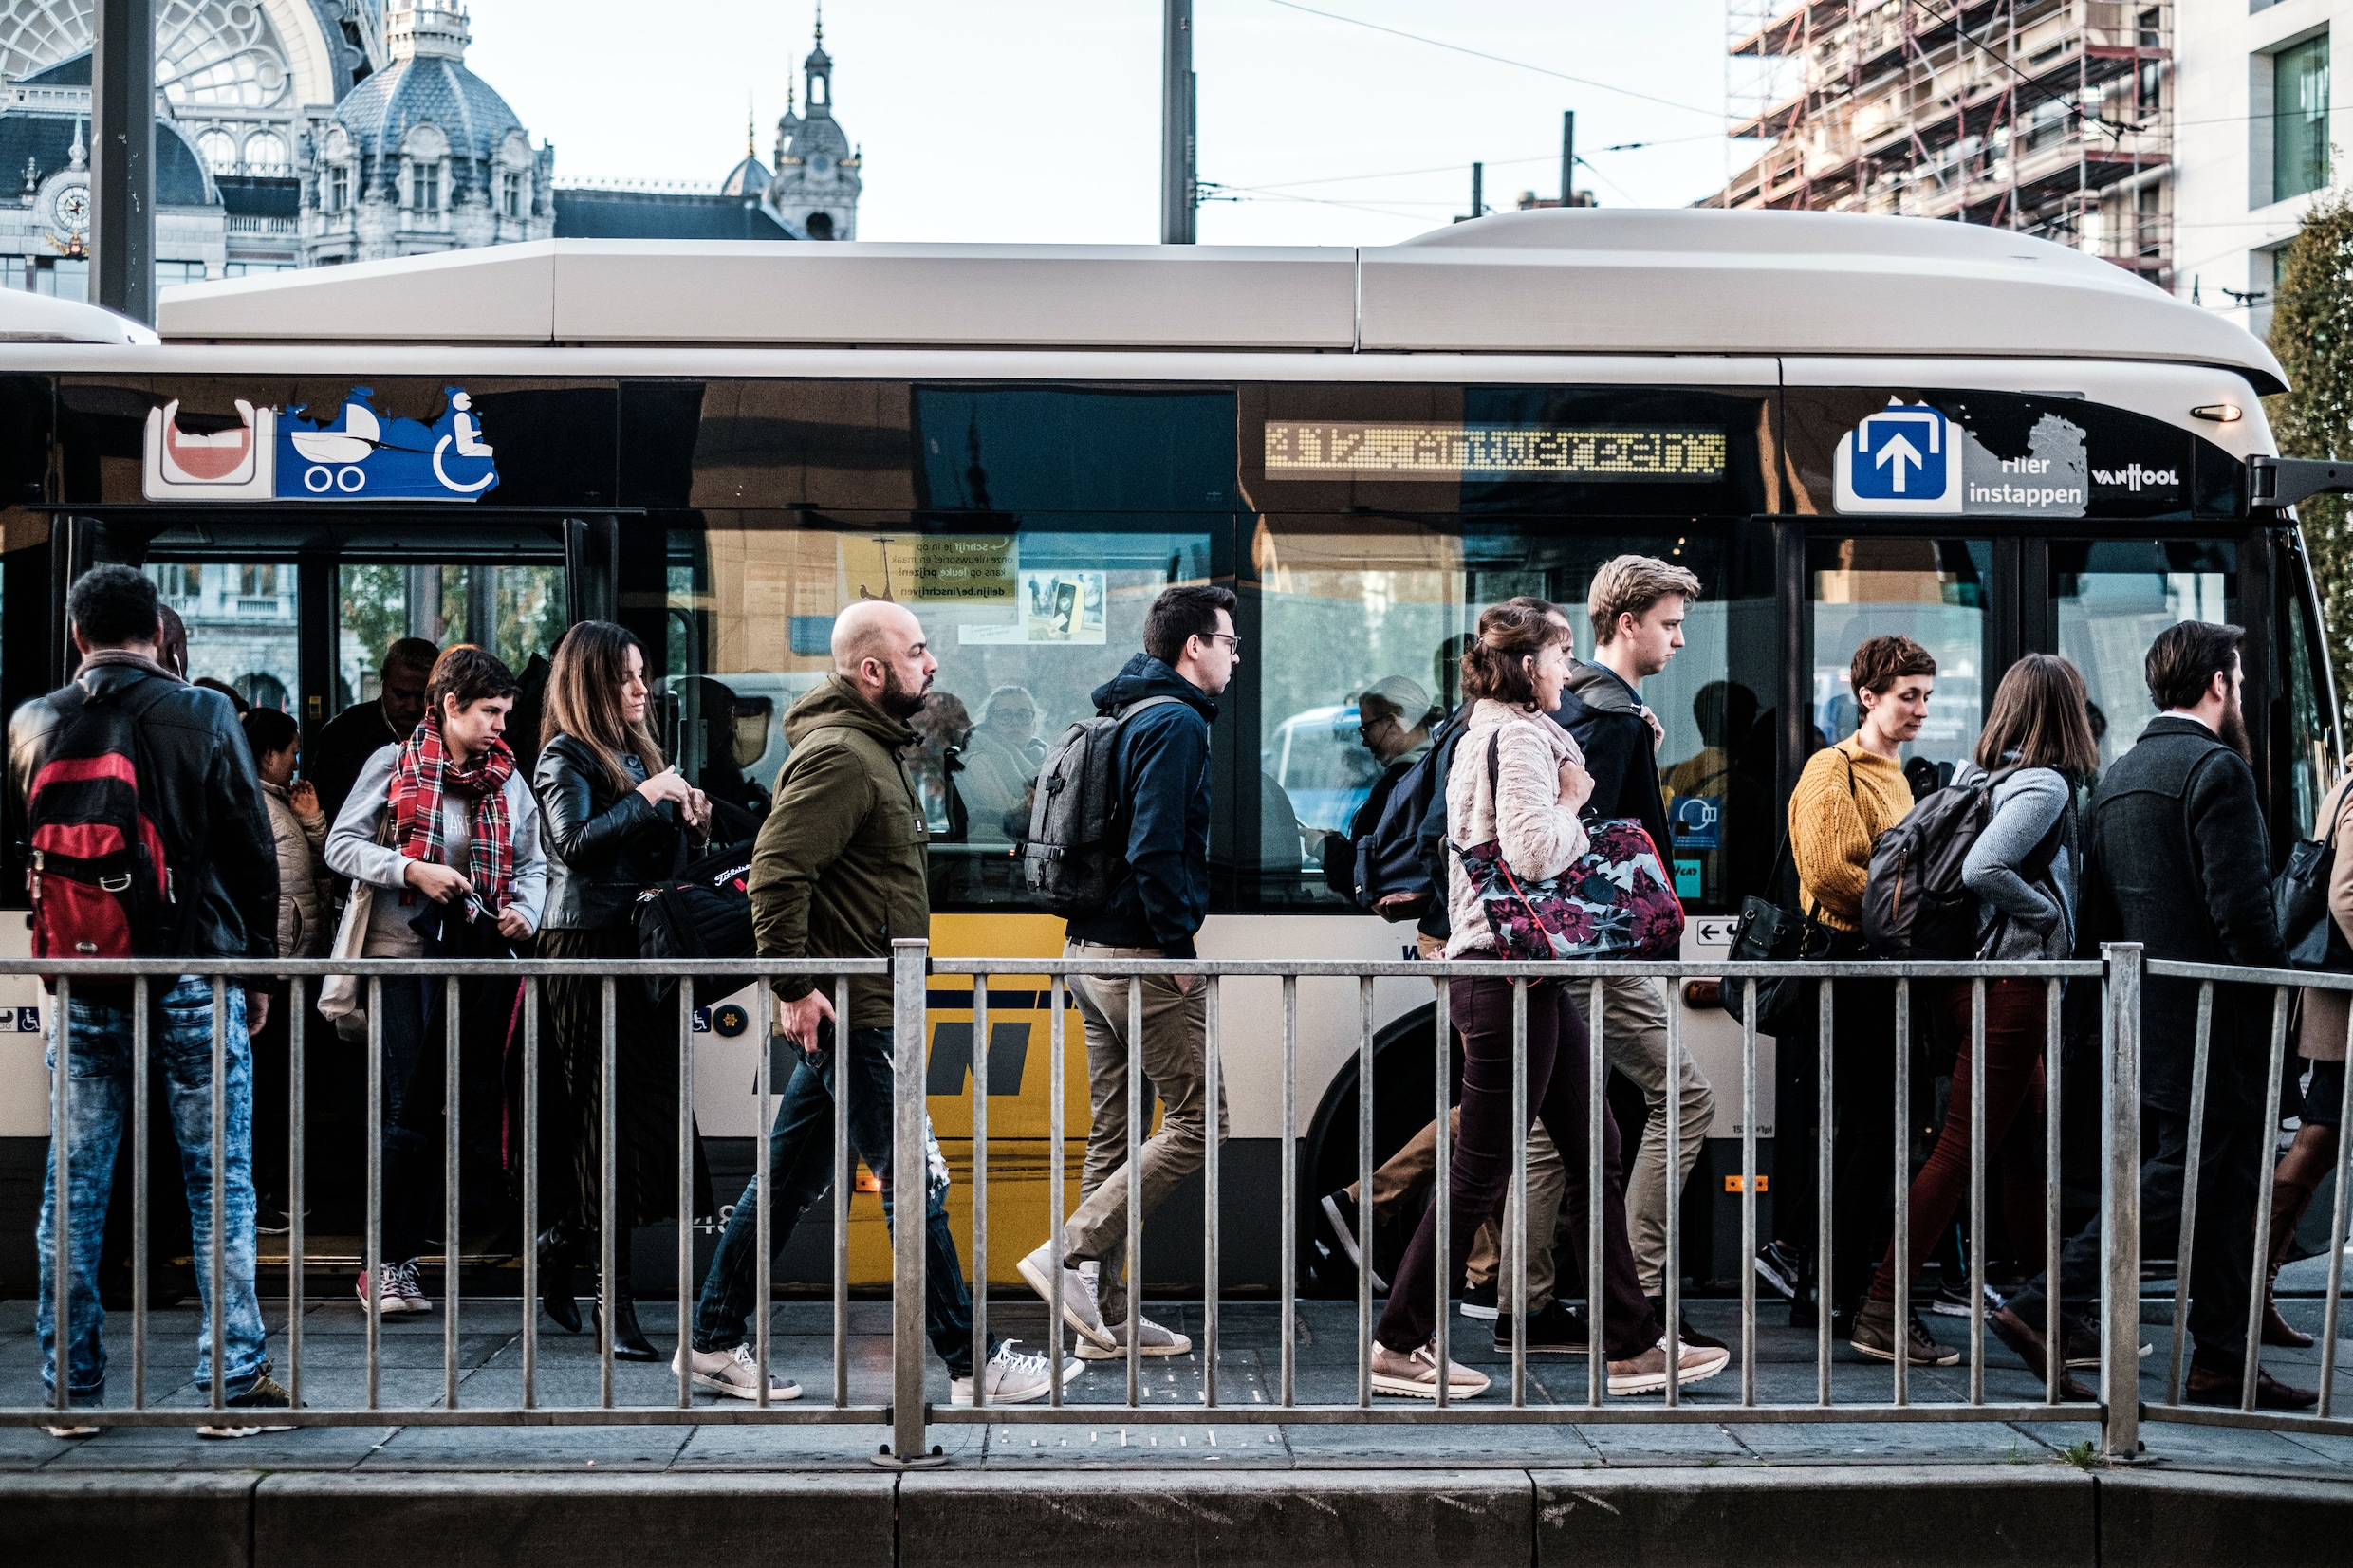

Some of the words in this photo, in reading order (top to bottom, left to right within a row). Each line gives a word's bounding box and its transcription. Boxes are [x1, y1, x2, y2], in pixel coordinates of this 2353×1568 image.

[1413, 428, 1688, 469] Antwerpen
[2001, 456, 2051, 474] Hier
[1969, 482, 2082, 507] instappen
